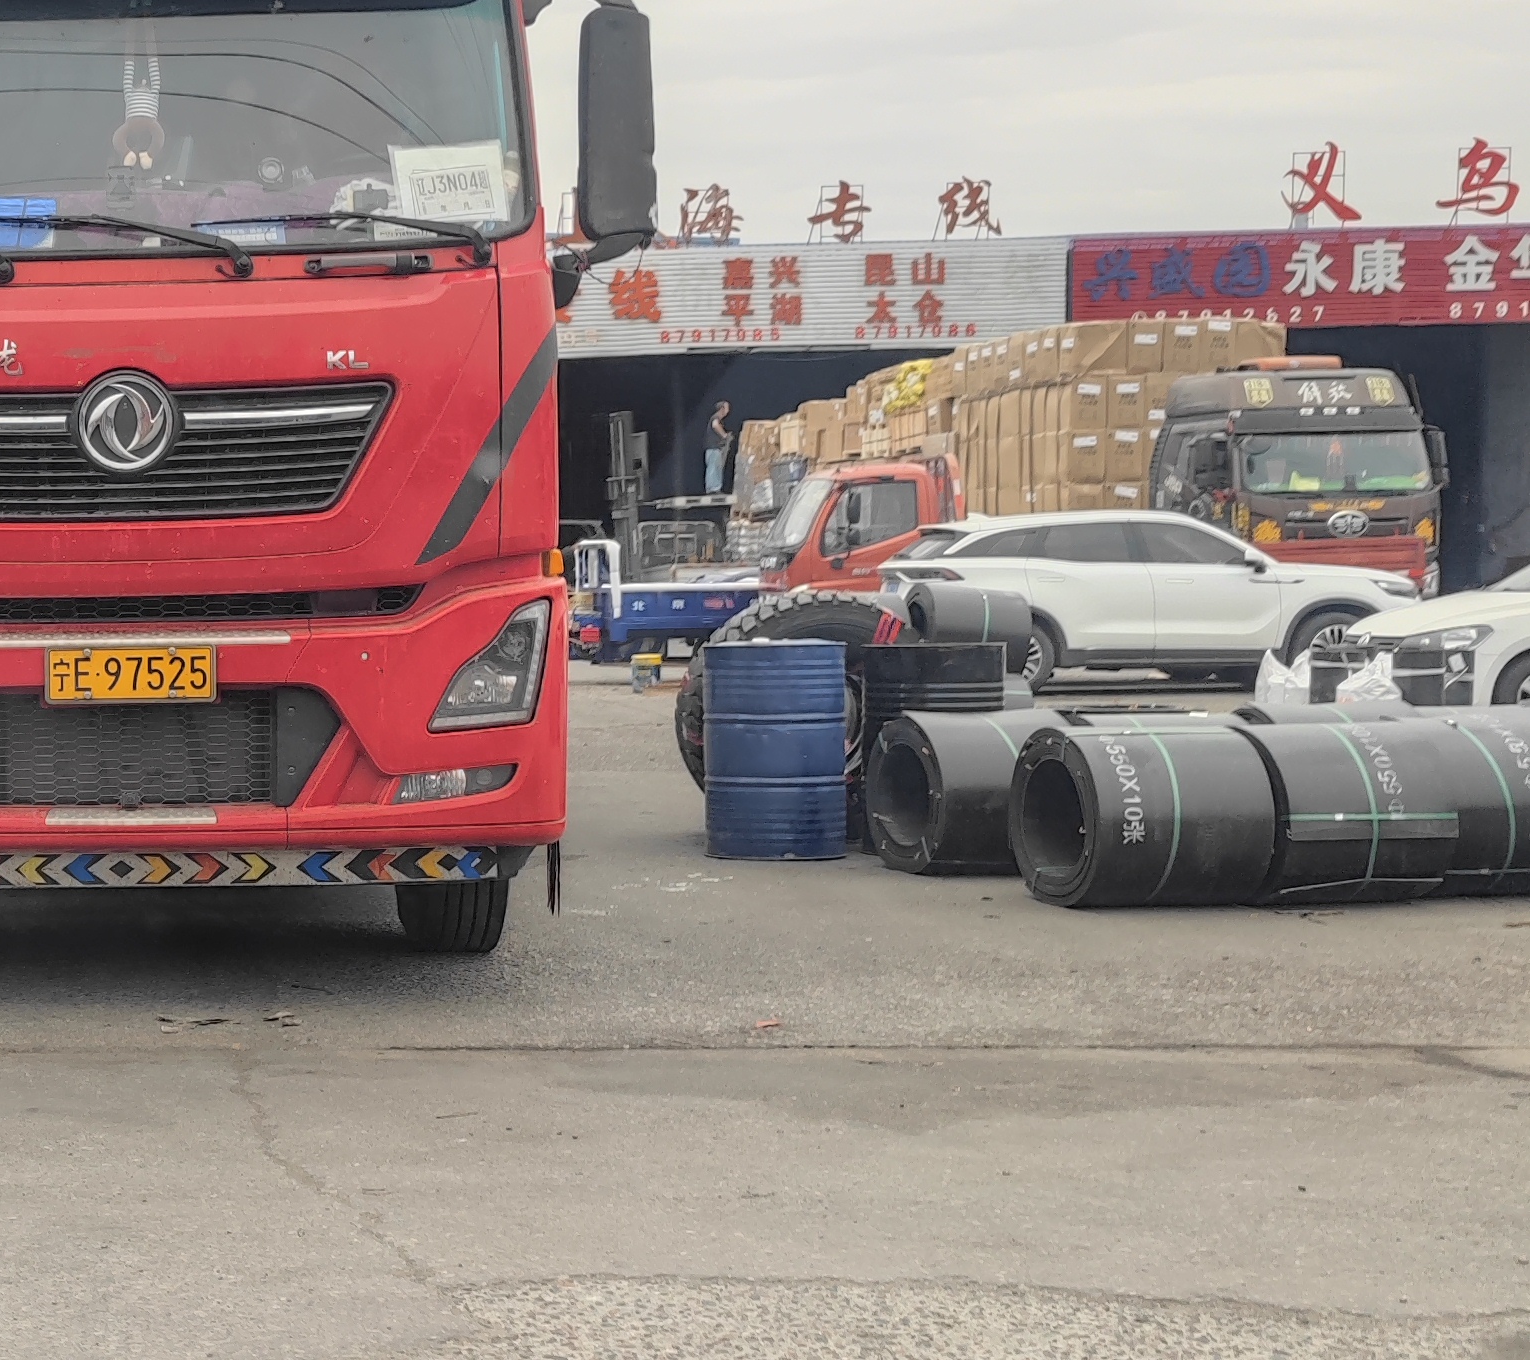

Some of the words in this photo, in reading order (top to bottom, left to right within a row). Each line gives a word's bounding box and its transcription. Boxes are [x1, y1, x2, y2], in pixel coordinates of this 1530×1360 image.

[1280, 137, 1520, 222] 义乌
[552, 176, 1002, 249] 海专线
[721, 256, 801, 290] 嘉兴
[864, 252, 946, 286] 昆山
[1282, 239, 1407, 298] 永康
[721, 292, 803, 327] 平湖
[866, 289, 945, 325] 太仓
[327, 349, 370, 370] KL
[53, 654, 208, 692] 宁E·97525
